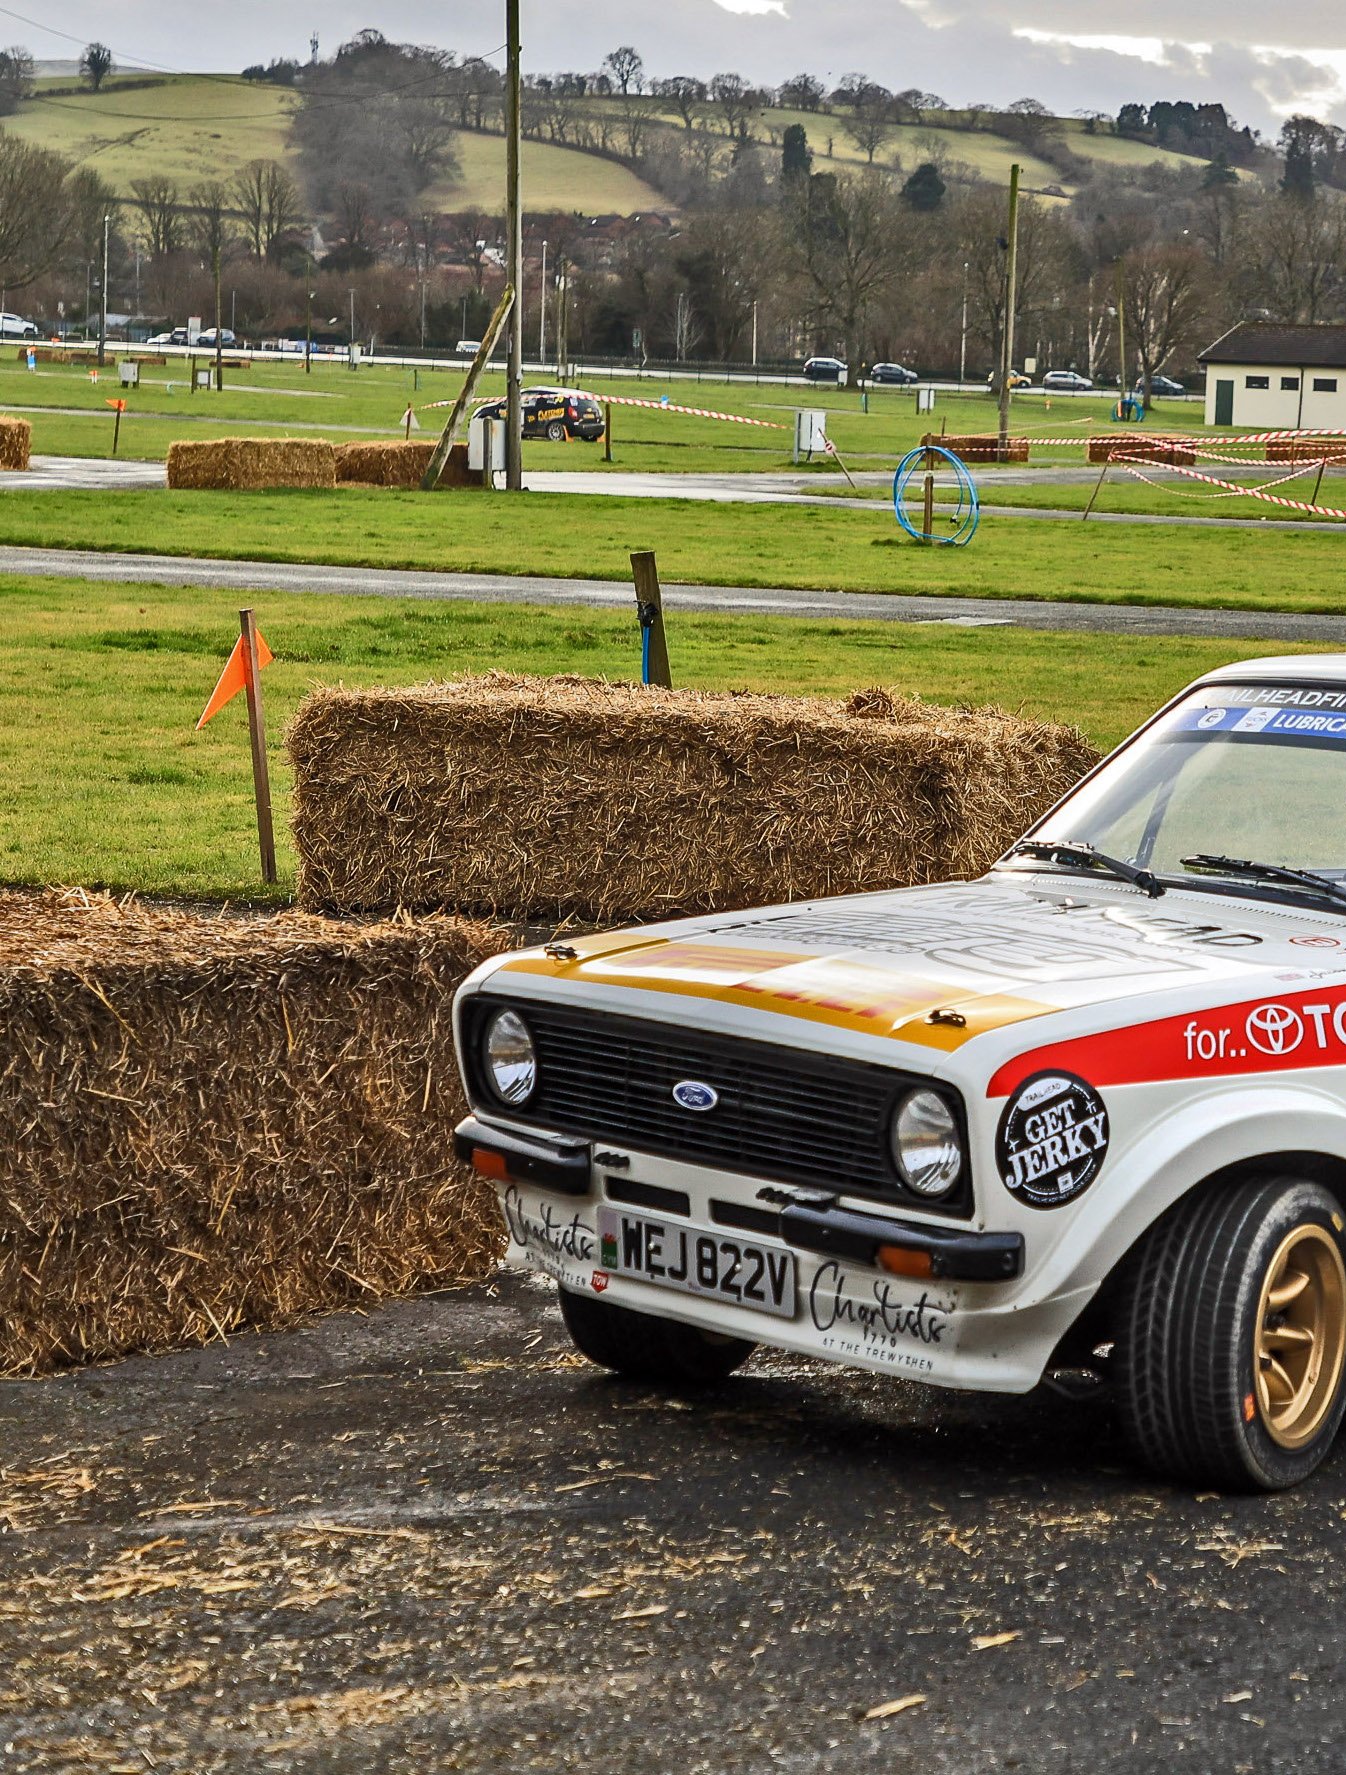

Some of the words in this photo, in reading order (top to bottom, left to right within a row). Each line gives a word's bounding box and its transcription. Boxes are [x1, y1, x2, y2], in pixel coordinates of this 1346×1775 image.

[1024, 1099, 1077, 1144] GET
[1005, 1111, 1107, 1189] JERKY
[593, 1273, 607, 1286] TOW
[621, 1217, 689, 1282] WEJ
[696, 1236, 788, 1306] 822V
[822, 1337, 836, 1347] AT
[841, 1340, 860, 1355] THE
[866, 1347, 934, 1371] TREWYTHEN
